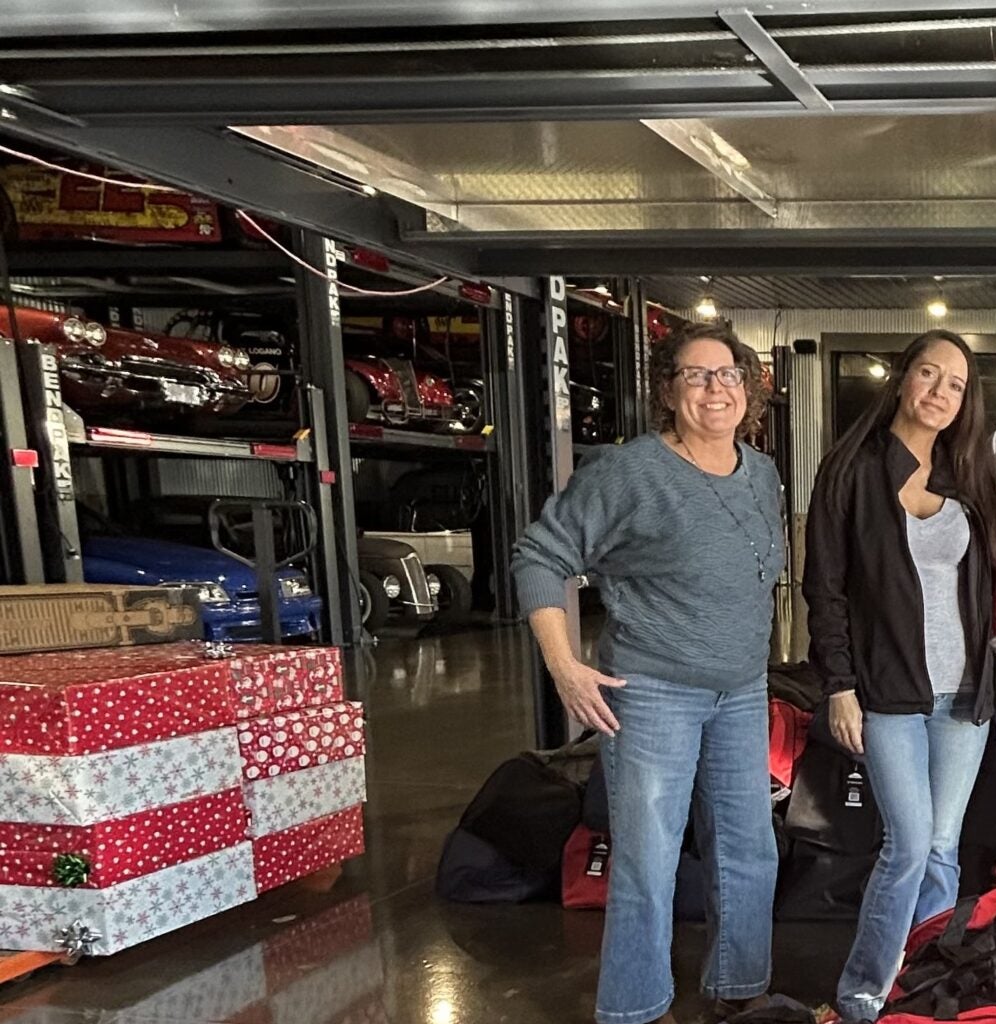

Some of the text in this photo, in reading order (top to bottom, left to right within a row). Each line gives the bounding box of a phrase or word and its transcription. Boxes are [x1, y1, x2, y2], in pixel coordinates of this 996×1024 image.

[324, 238, 340, 310] NDPAK
[248, 347, 282, 356] LOGANO
[550, 275, 570, 395] DPAK
[41, 353, 72, 480] BENDPAK
